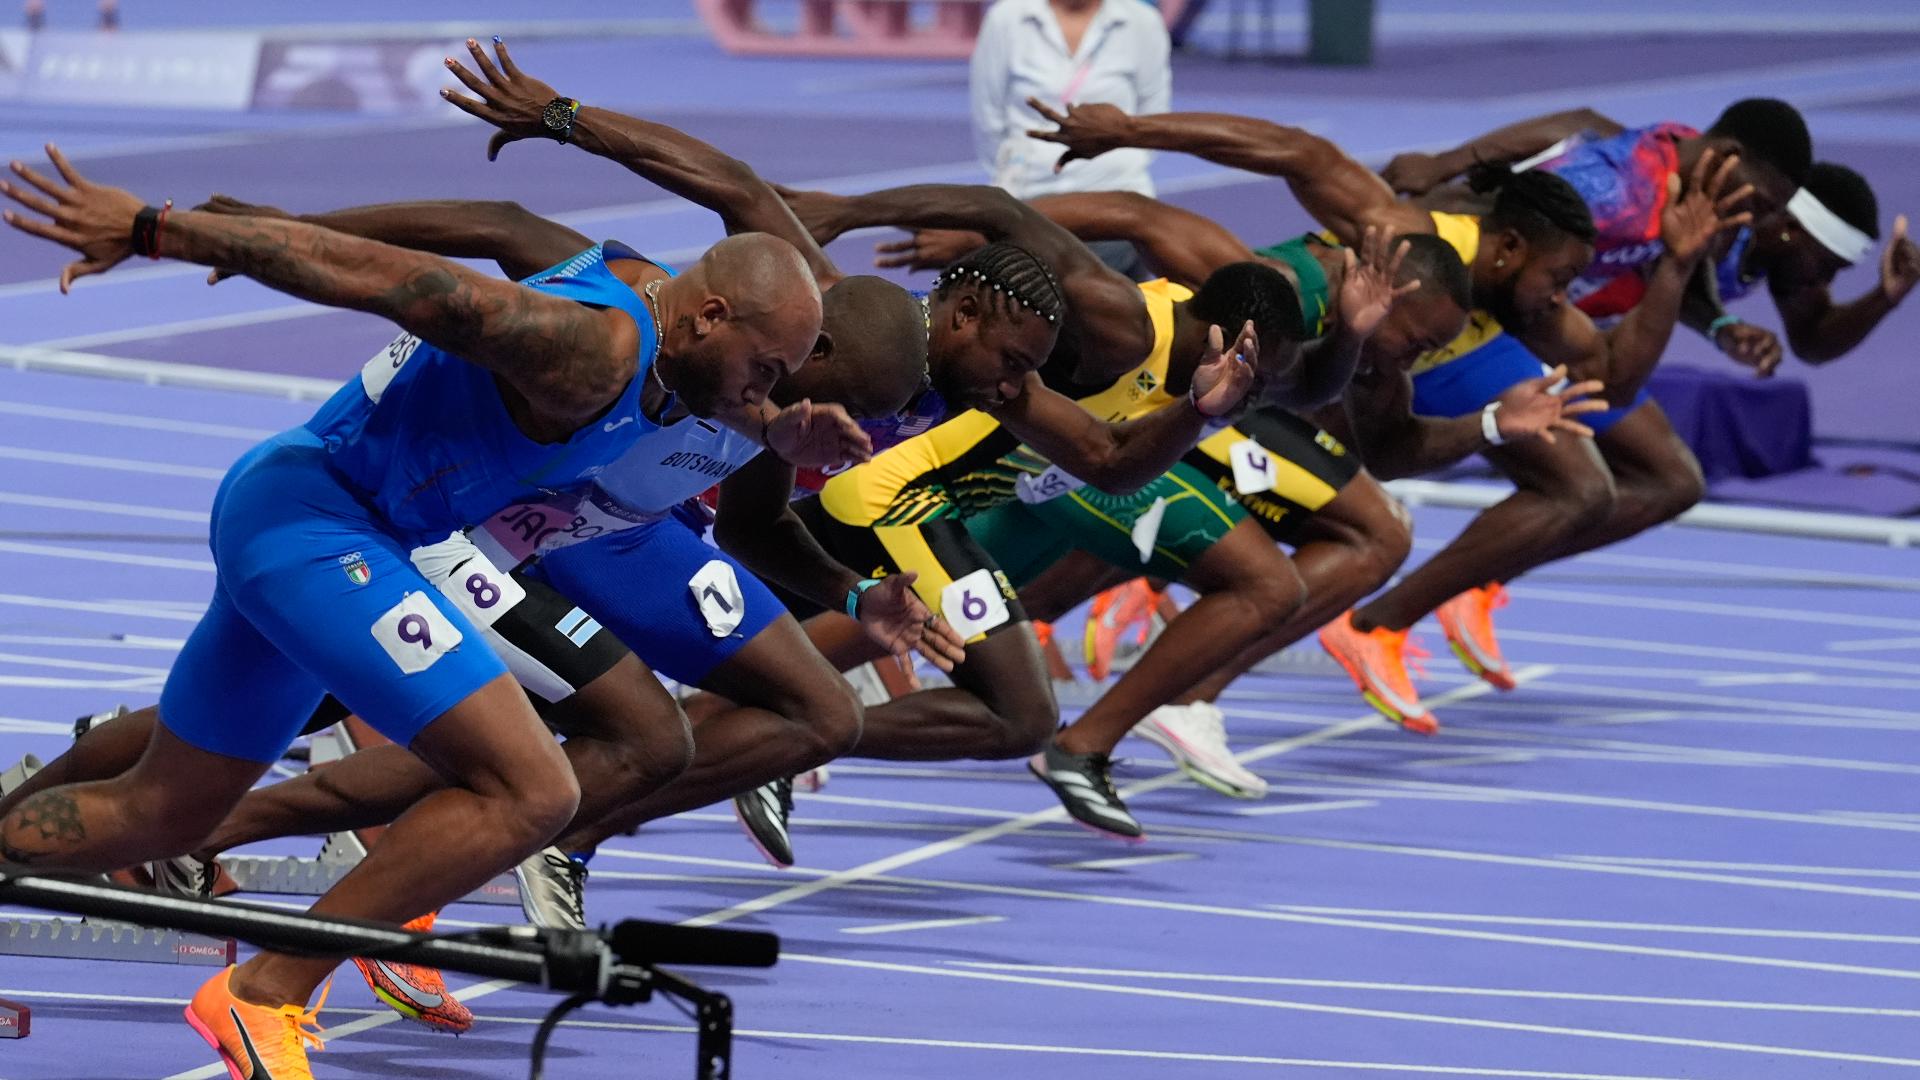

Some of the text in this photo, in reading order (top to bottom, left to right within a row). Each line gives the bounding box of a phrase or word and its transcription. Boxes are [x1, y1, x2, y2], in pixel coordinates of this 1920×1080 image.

[465, 572, 501, 609] 8
[962, 588, 988, 621] 6
[397, 613, 433, 651] 9
[189, 945, 220, 956] OMEGA
